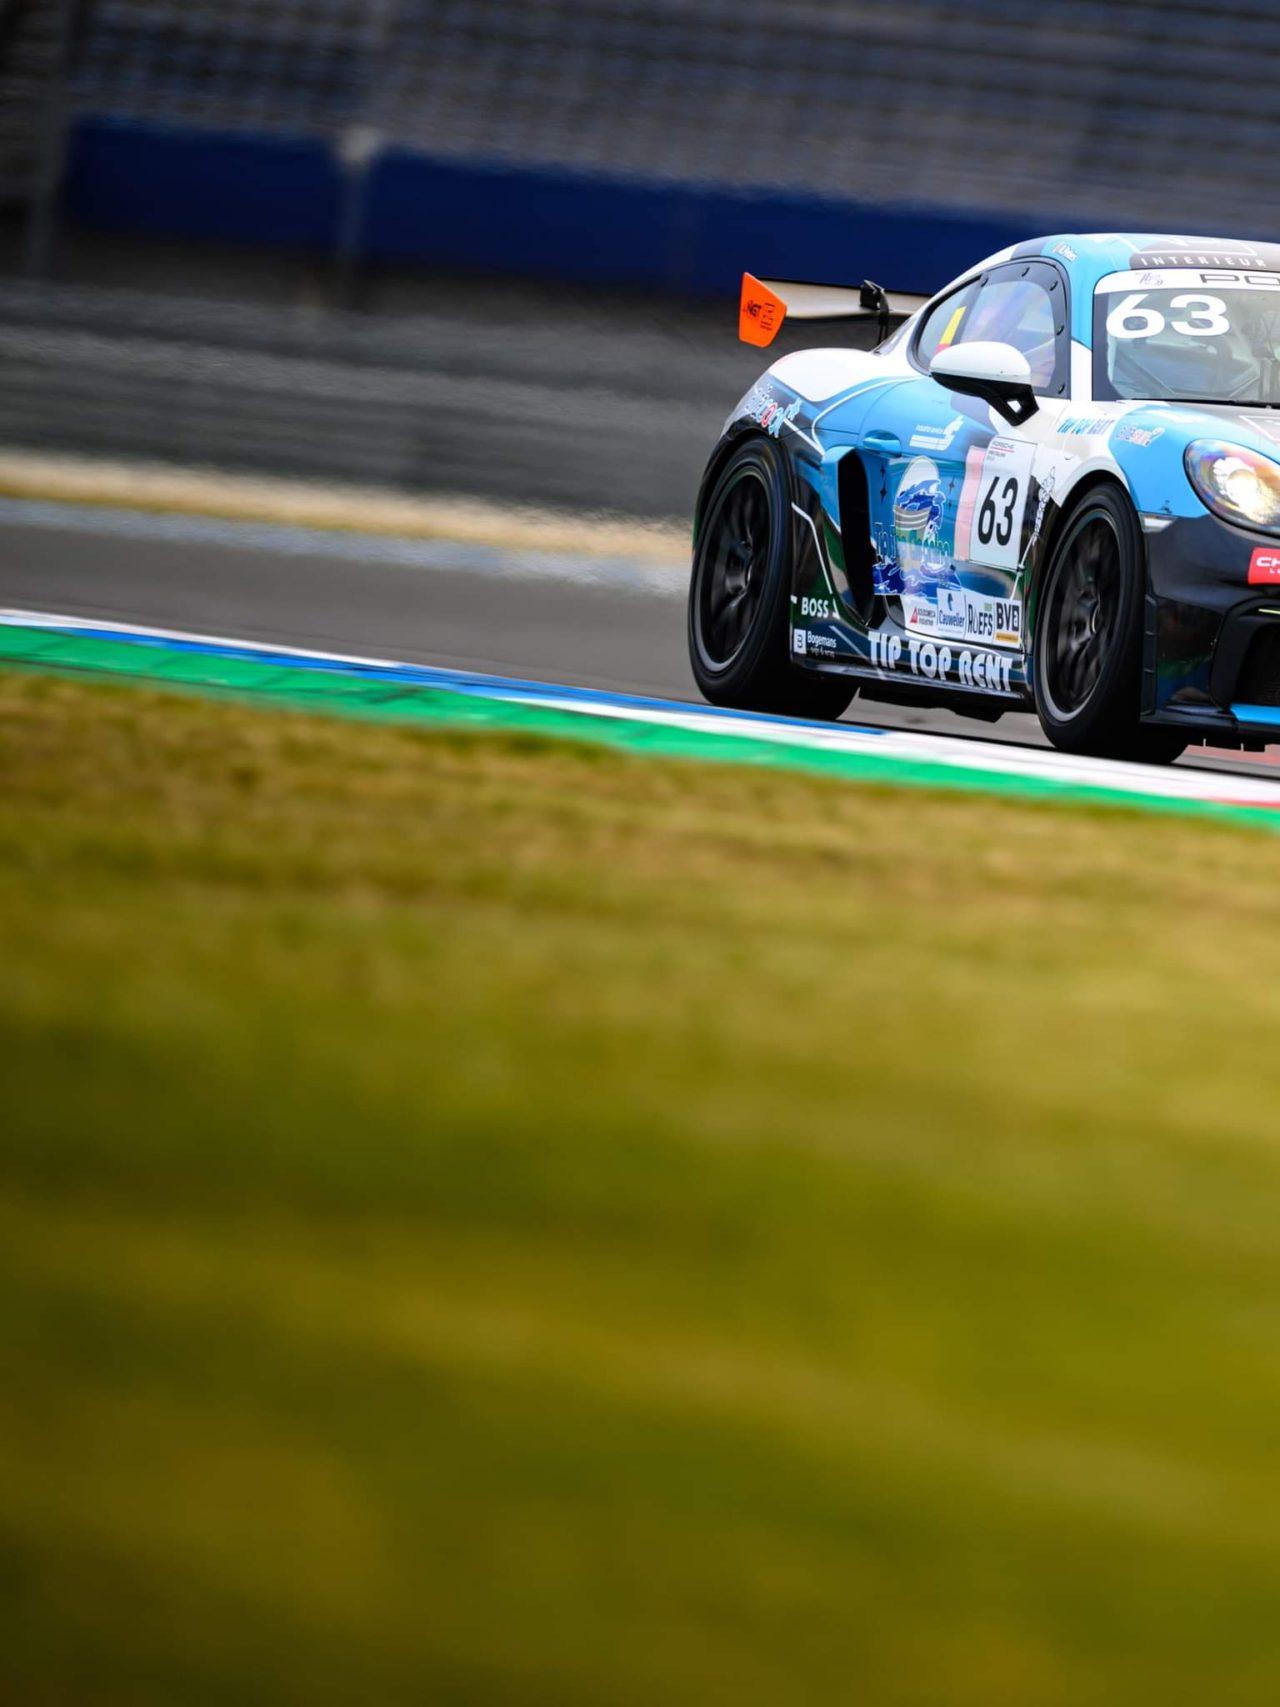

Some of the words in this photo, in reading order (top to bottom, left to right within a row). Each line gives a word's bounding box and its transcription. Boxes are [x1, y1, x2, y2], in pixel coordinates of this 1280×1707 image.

[1139, 255, 1267, 269] INTERIEUR
[1106, 293, 1231, 339] 63
[978, 476, 1018, 546] 63
[801, 597, 829, 619] BOSS
[868, 630, 902, 670] TIP
[908, 639, 952, 681] TOP
[958, 650, 1013, 692] RENT
